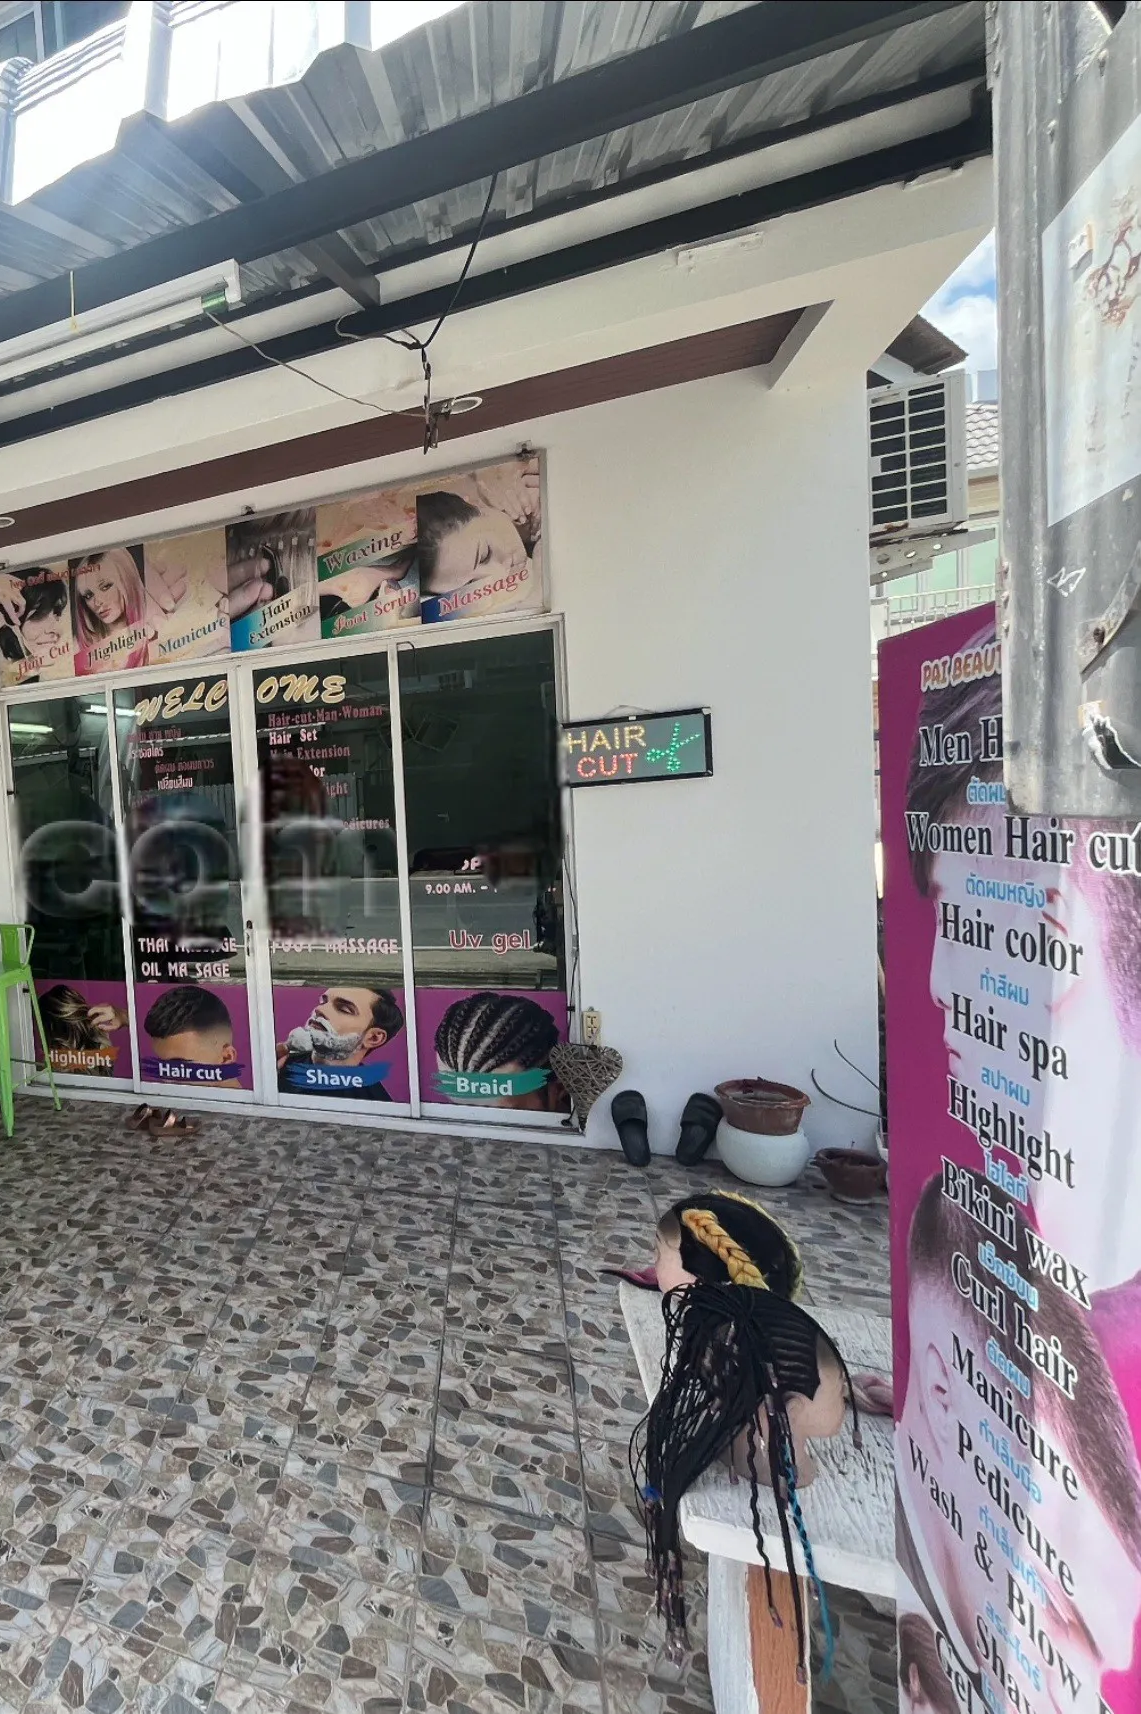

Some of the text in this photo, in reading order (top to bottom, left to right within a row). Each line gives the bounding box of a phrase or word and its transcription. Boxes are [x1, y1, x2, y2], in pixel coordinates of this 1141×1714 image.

[324, 531, 402, 574] Waxing
[374, 588, 417, 616] Scrub
[438, 568, 529, 617] Massage
[249, 605, 312, 645] Extension
[260, 598, 292, 627] Hair
[85, 626, 147, 670] Highlight
[158, 616, 226, 656] Manicure
[15, 642, 70, 681] Hair Cut
[921, 657, 949, 690] PAI
[269, 728, 318, 745] Hair Set
[297, 744, 351, 760] Extension
[566, 724, 647, 754] HAIR
[919, 724, 972, 767] Men
[576, 752, 639, 778] CUT
[905, 812, 1141, 877] Women Hair cut
[425, 884, 450, 894] 9.00
[966, 872, 1045, 908] ตัดผมหญิง
[138, 938, 169, 953] THAI
[449, 929, 530, 954] Uv gel
[940, 902, 1084, 977] Hair color
[141, 962, 231, 978] OIL MASAGE
[980, 969, 1029, 1006] ทำสีผม
[951, 992, 1069, 1082] Hair spa
[158, 1061, 223, 1081] Hair cut
[306, 1067, 363, 1088] Shave
[456, 1076, 513, 1098] Braid
[981, 1066, 1030, 1107] สปาผม
[947, 1074, 1076, 1190] Highlight
[941, 1154, 1093, 1311] Bikini wax
[951, 1251, 1079, 1400] Curl hair
[950, 1331, 1080, 1502] Manicure
[908, 1434, 1082, 1702] Wash & Blow
